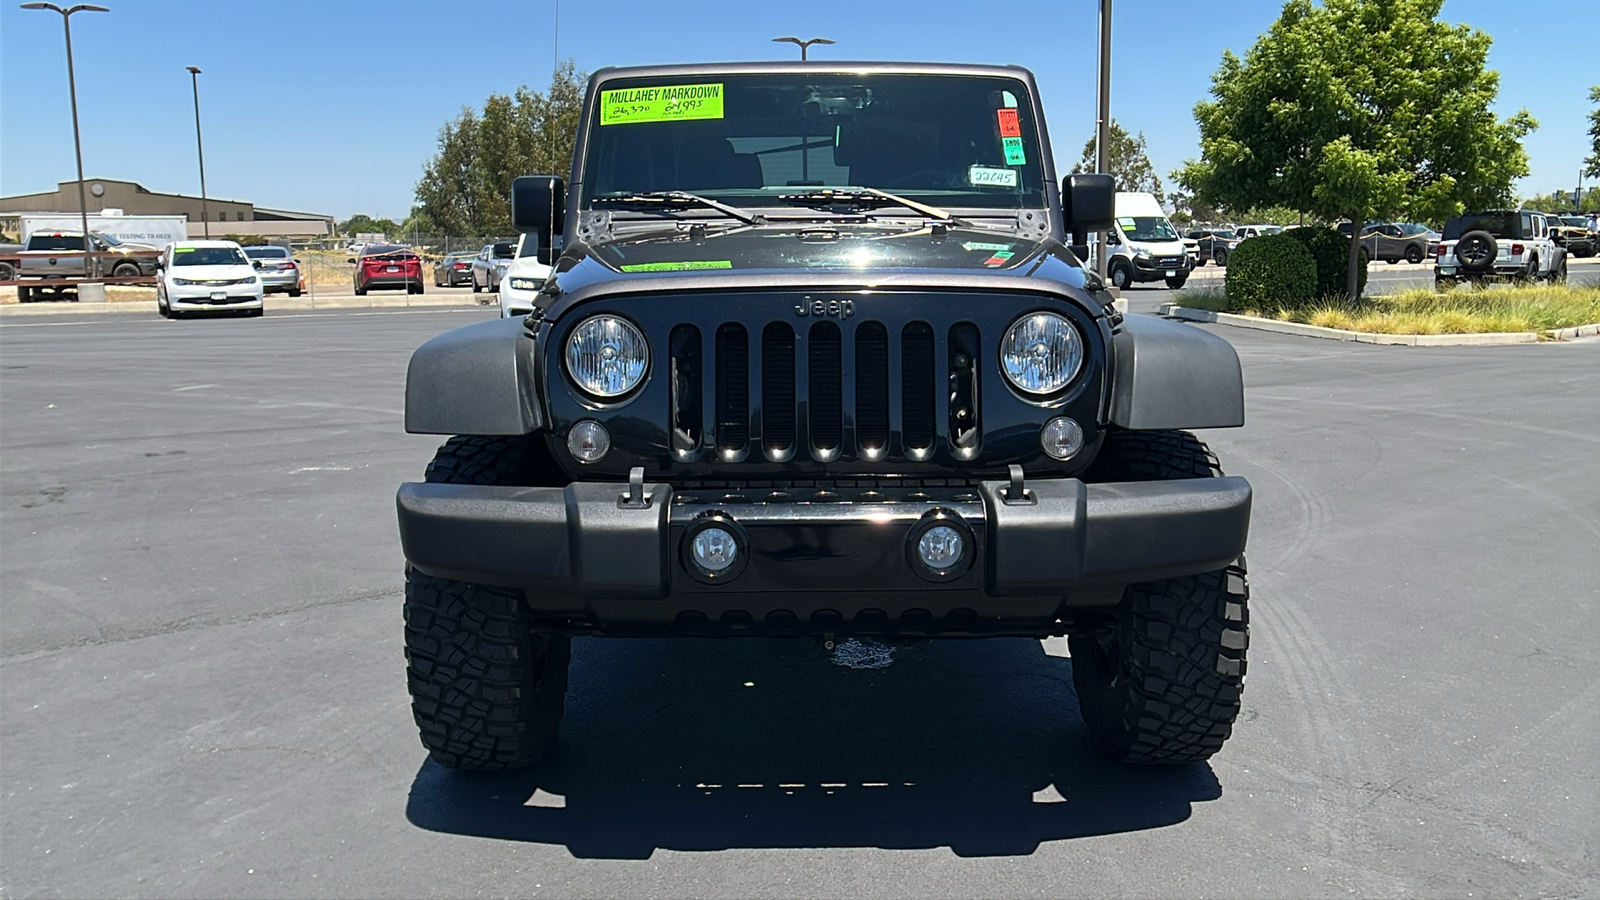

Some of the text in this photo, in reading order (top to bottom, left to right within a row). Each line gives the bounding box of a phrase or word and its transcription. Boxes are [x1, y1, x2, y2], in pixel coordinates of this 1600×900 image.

[609, 86, 719, 104] MULLAHEY MARKDOWN
[975, 172, 1013, 183] 22645
[795, 296, 856, 320] Jeep
